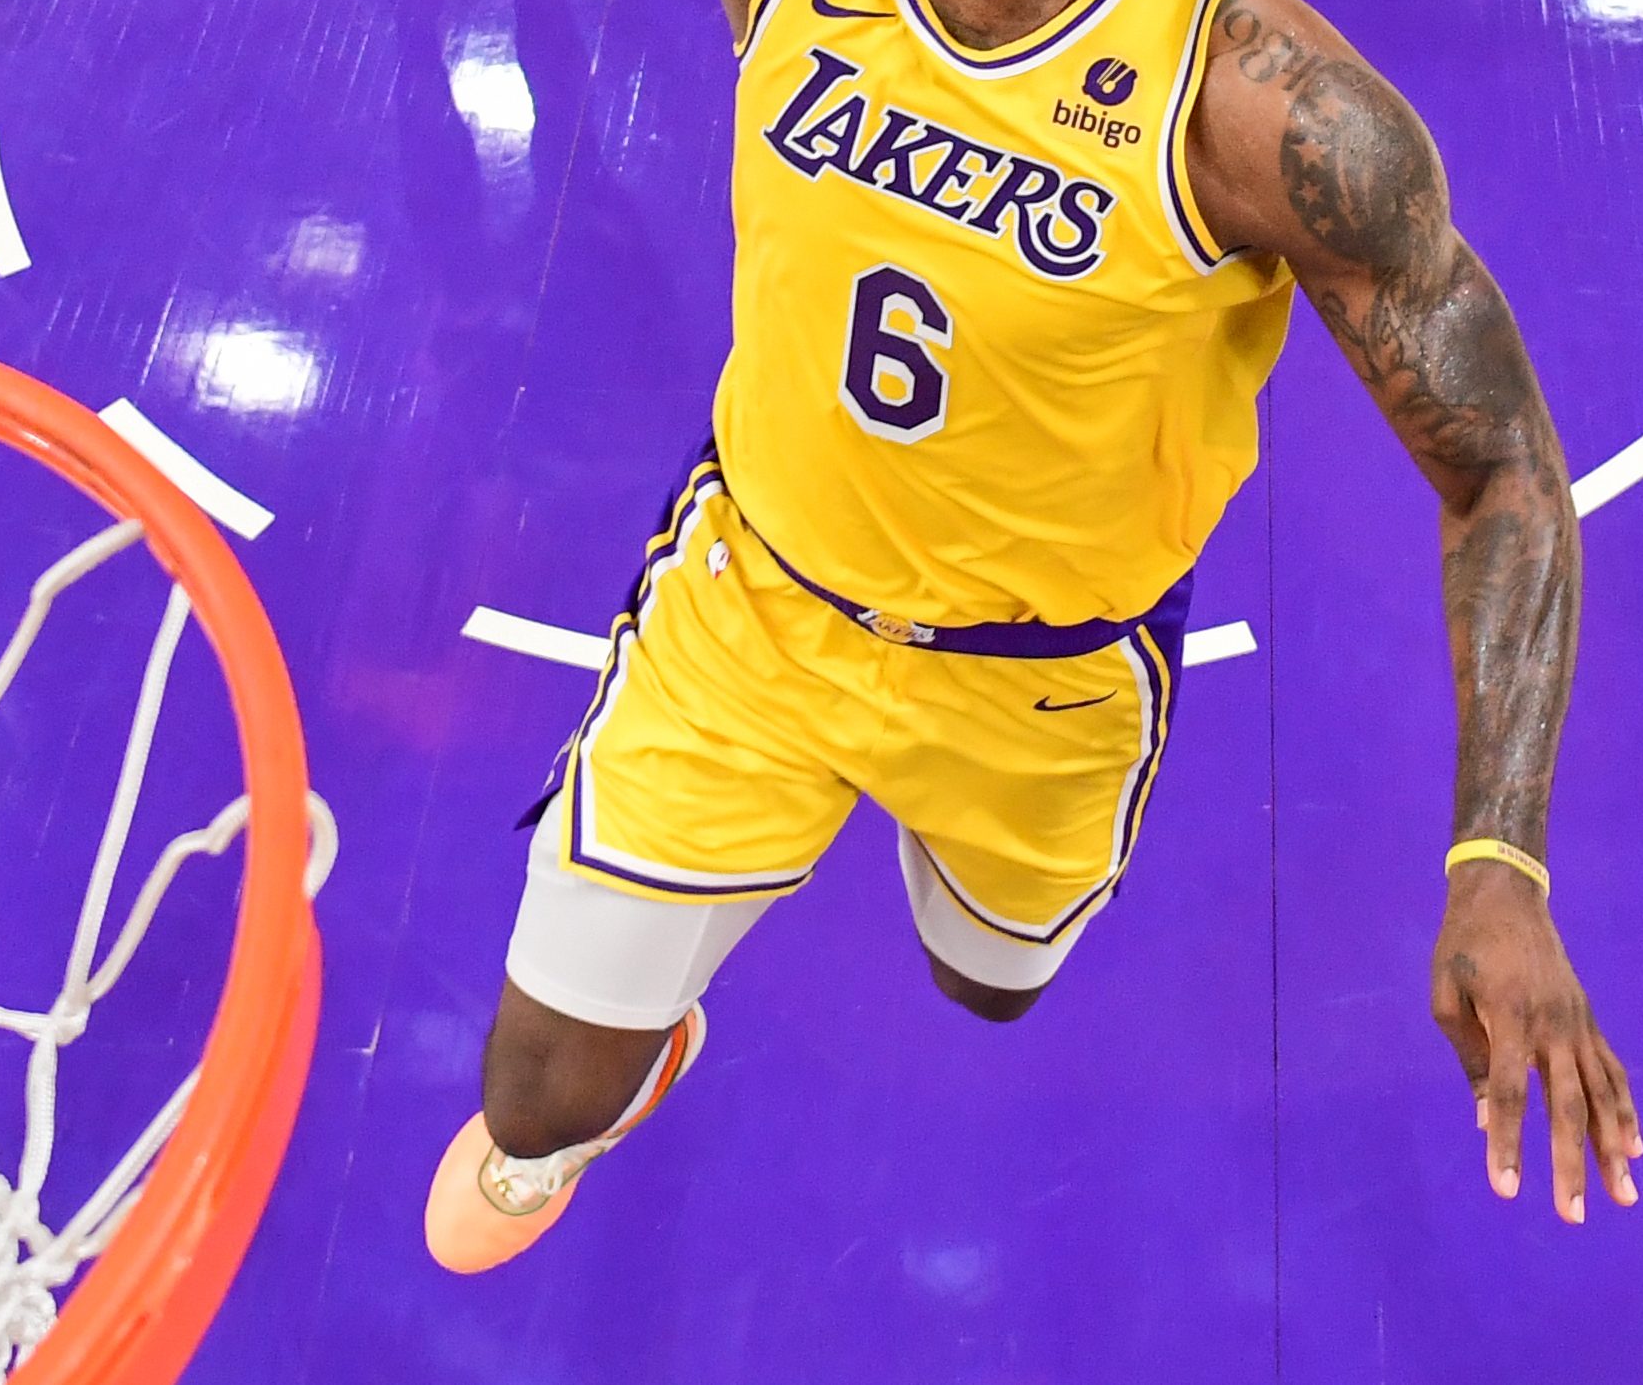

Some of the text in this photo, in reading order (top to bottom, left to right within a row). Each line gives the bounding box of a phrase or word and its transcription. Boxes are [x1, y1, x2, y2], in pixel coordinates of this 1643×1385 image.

[761, 41, 1117, 282] LAKERS
[1052, 99, 1142, 148] bibigo
[837, 261, 953, 445] 6
